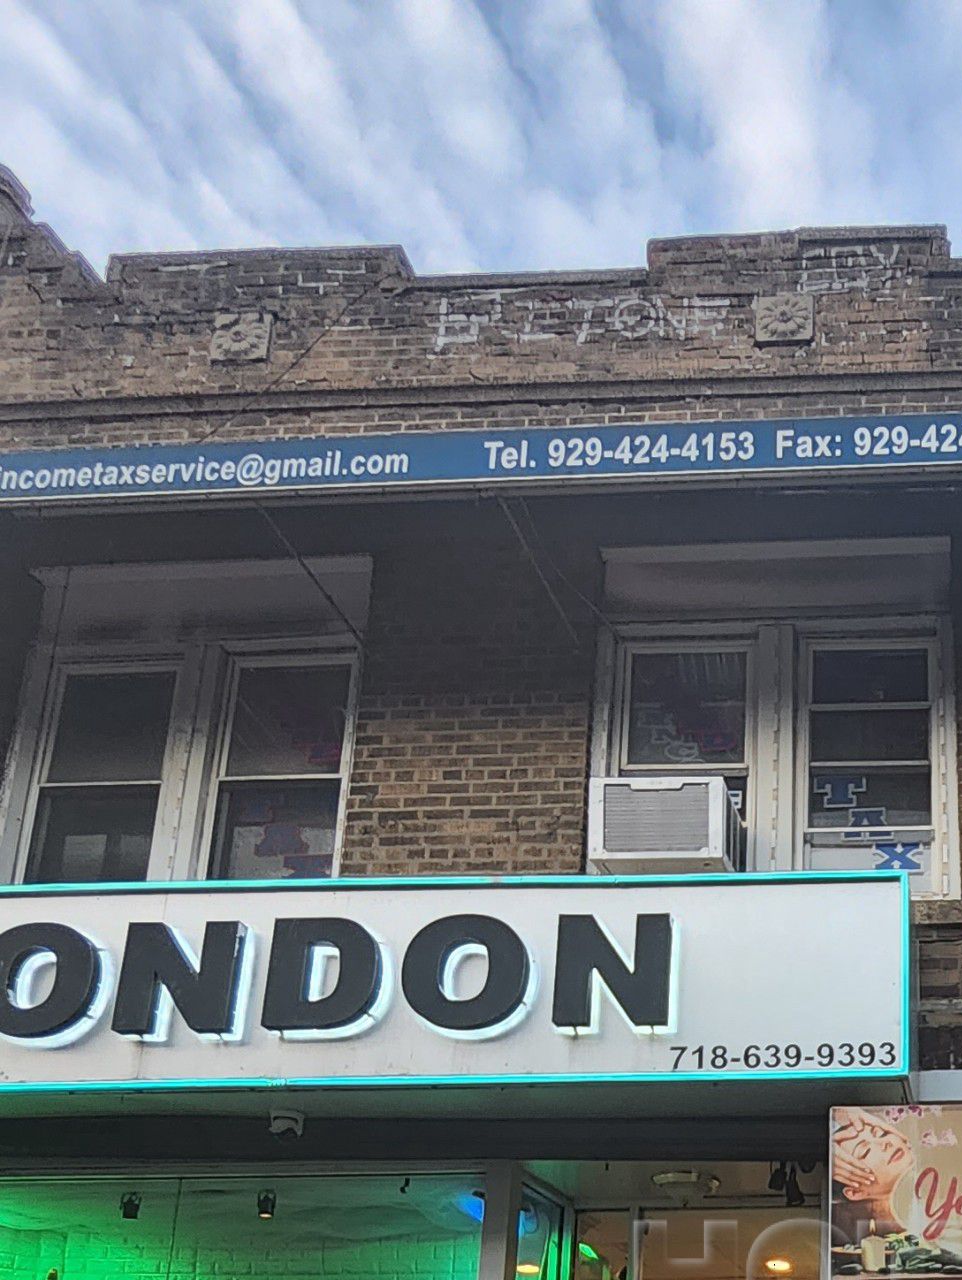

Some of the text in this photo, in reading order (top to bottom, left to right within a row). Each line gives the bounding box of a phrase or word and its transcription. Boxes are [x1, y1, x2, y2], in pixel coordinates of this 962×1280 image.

[484, 440, 536, 470] Tel.
[548, 431, 755, 467] 929-424-4153
[775, 428, 842, 460] Fax:
[669, 1042, 896, 1070] 718-639-9393
